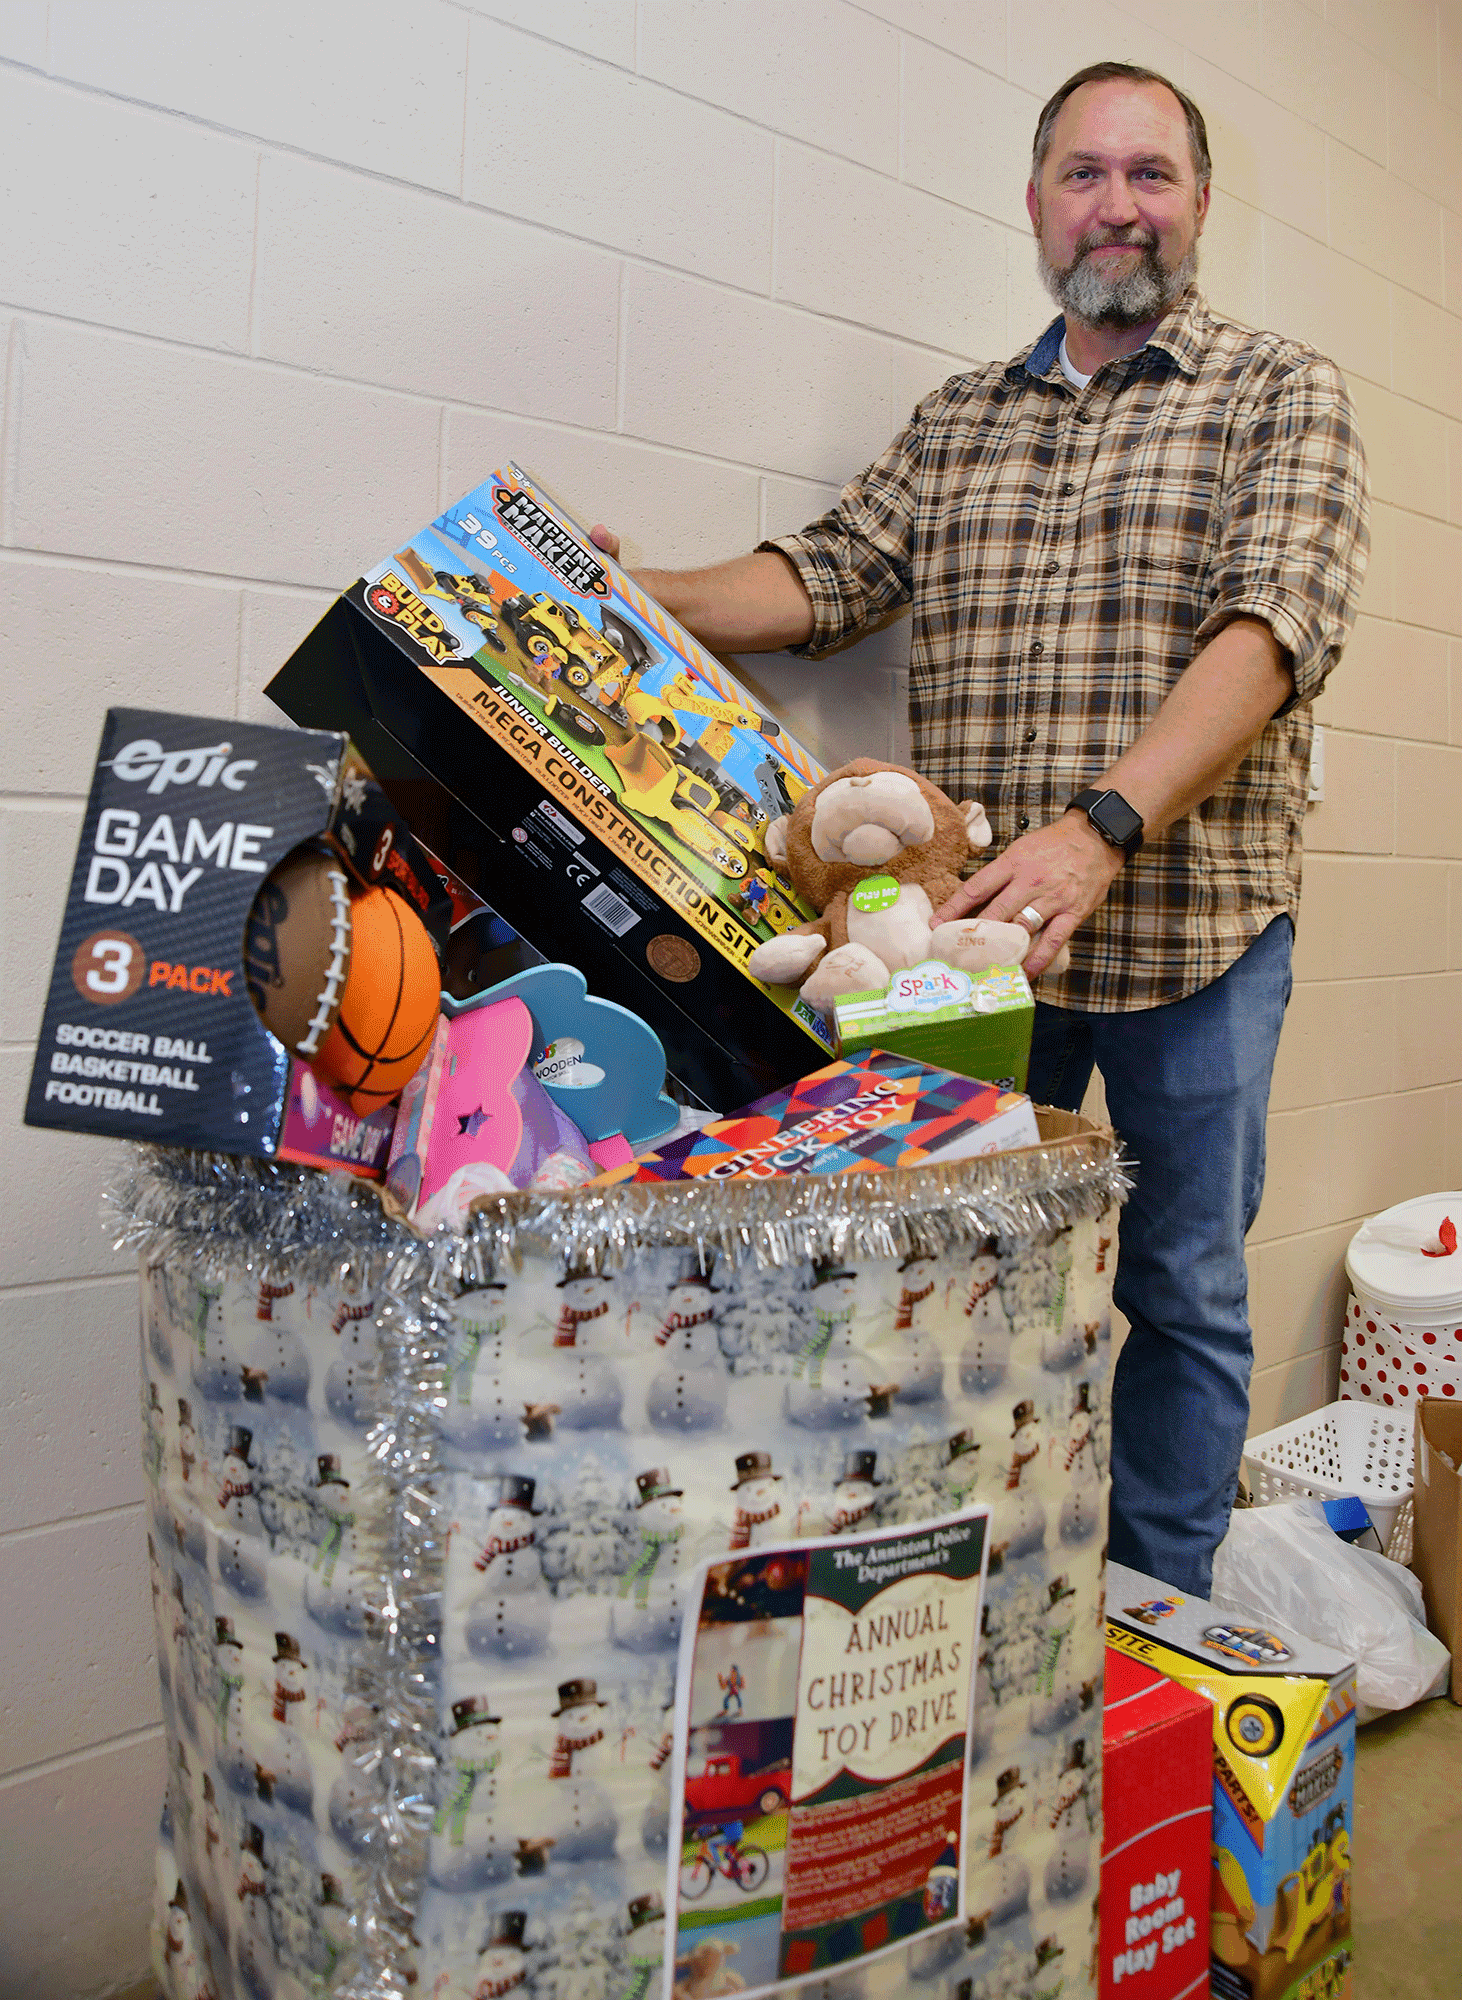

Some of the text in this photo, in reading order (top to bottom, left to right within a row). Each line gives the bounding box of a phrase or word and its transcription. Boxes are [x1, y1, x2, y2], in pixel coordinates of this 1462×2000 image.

[510, 468, 532, 488] 3+
[457, 512, 518, 574] 39 PCS
[502, 504, 591, 593] MAKER
[503, 521, 575, 590] CONSTRUCTION SET
[515, 496, 601, 577] MACHINE
[377, 595, 392, 608] &
[380, 572, 445, 633] BUILD
[394, 608, 457, 660] PLAY
[99, 739, 259, 795] epic
[492, 685, 612, 797] JUNIOR BUILDER
[95, 808, 274, 873] GAME
[373, 829, 393, 871] 3
[472, 691, 542, 760] MEGA
[544, 757, 719, 925] CONSTRUCTION
[719, 922, 756, 958] SIT
[84, 855, 204, 913] DAY
[856, 887, 898, 901] Play Me
[87, 939, 234, 997] 3 PACK
[957, 937, 986, 947] SING
[899, 973, 959, 998] Spark
[50, 1051, 199, 1092] BASKETBALL
[55, 1023, 213, 1064] SOCCER BALL
[45, 1080, 163, 1116] FOOTBALL
[698, 1079, 904, 1181] GINEERING
[745, 1095, 906, 1181] UCK TOY
[833, 1550, 864, 1569] The
[933, 1527, 972, 1549] Police
[845, 1600, 948, 1654] ANNUAL
[1105, 1628, 1157, 1654] SITE
[807, 1641, 962, 1710] CHRISTMAS
[818, 1689, 957, 1760] TOY DRIVE
[1214, 1756, 1260, 1823] PARTS!
[1129, 1868, 1181, 1913] Baby
[1125, 1897, 1185, 1945] Room
[1113, 1916, 1196, 1984] Play Set
